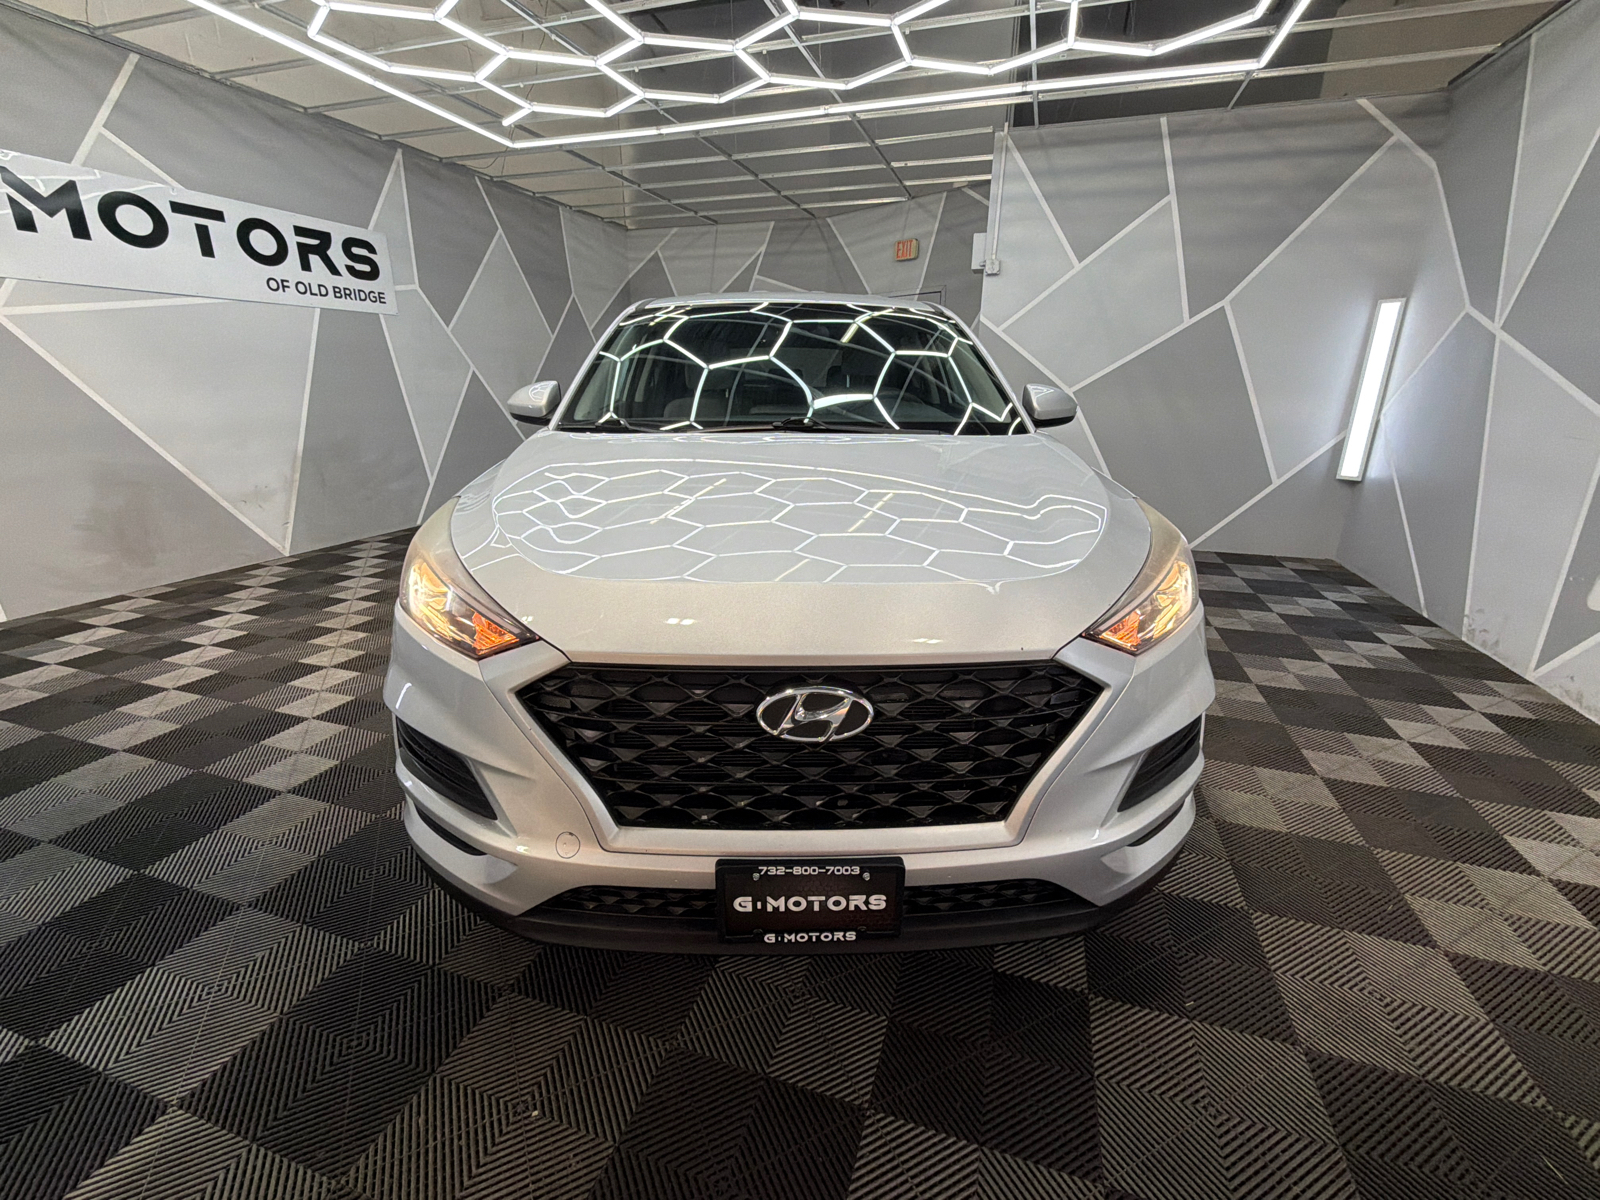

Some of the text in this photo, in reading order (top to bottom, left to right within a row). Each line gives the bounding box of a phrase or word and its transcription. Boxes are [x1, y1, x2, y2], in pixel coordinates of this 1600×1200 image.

[0, 166, 381, 282] MOTORS
[896, 240, 914, 259] EXIT
[266, 277, 387, 304] OF OLD BRIDGE
[758, 866, 860, 875] 732-800-7003
